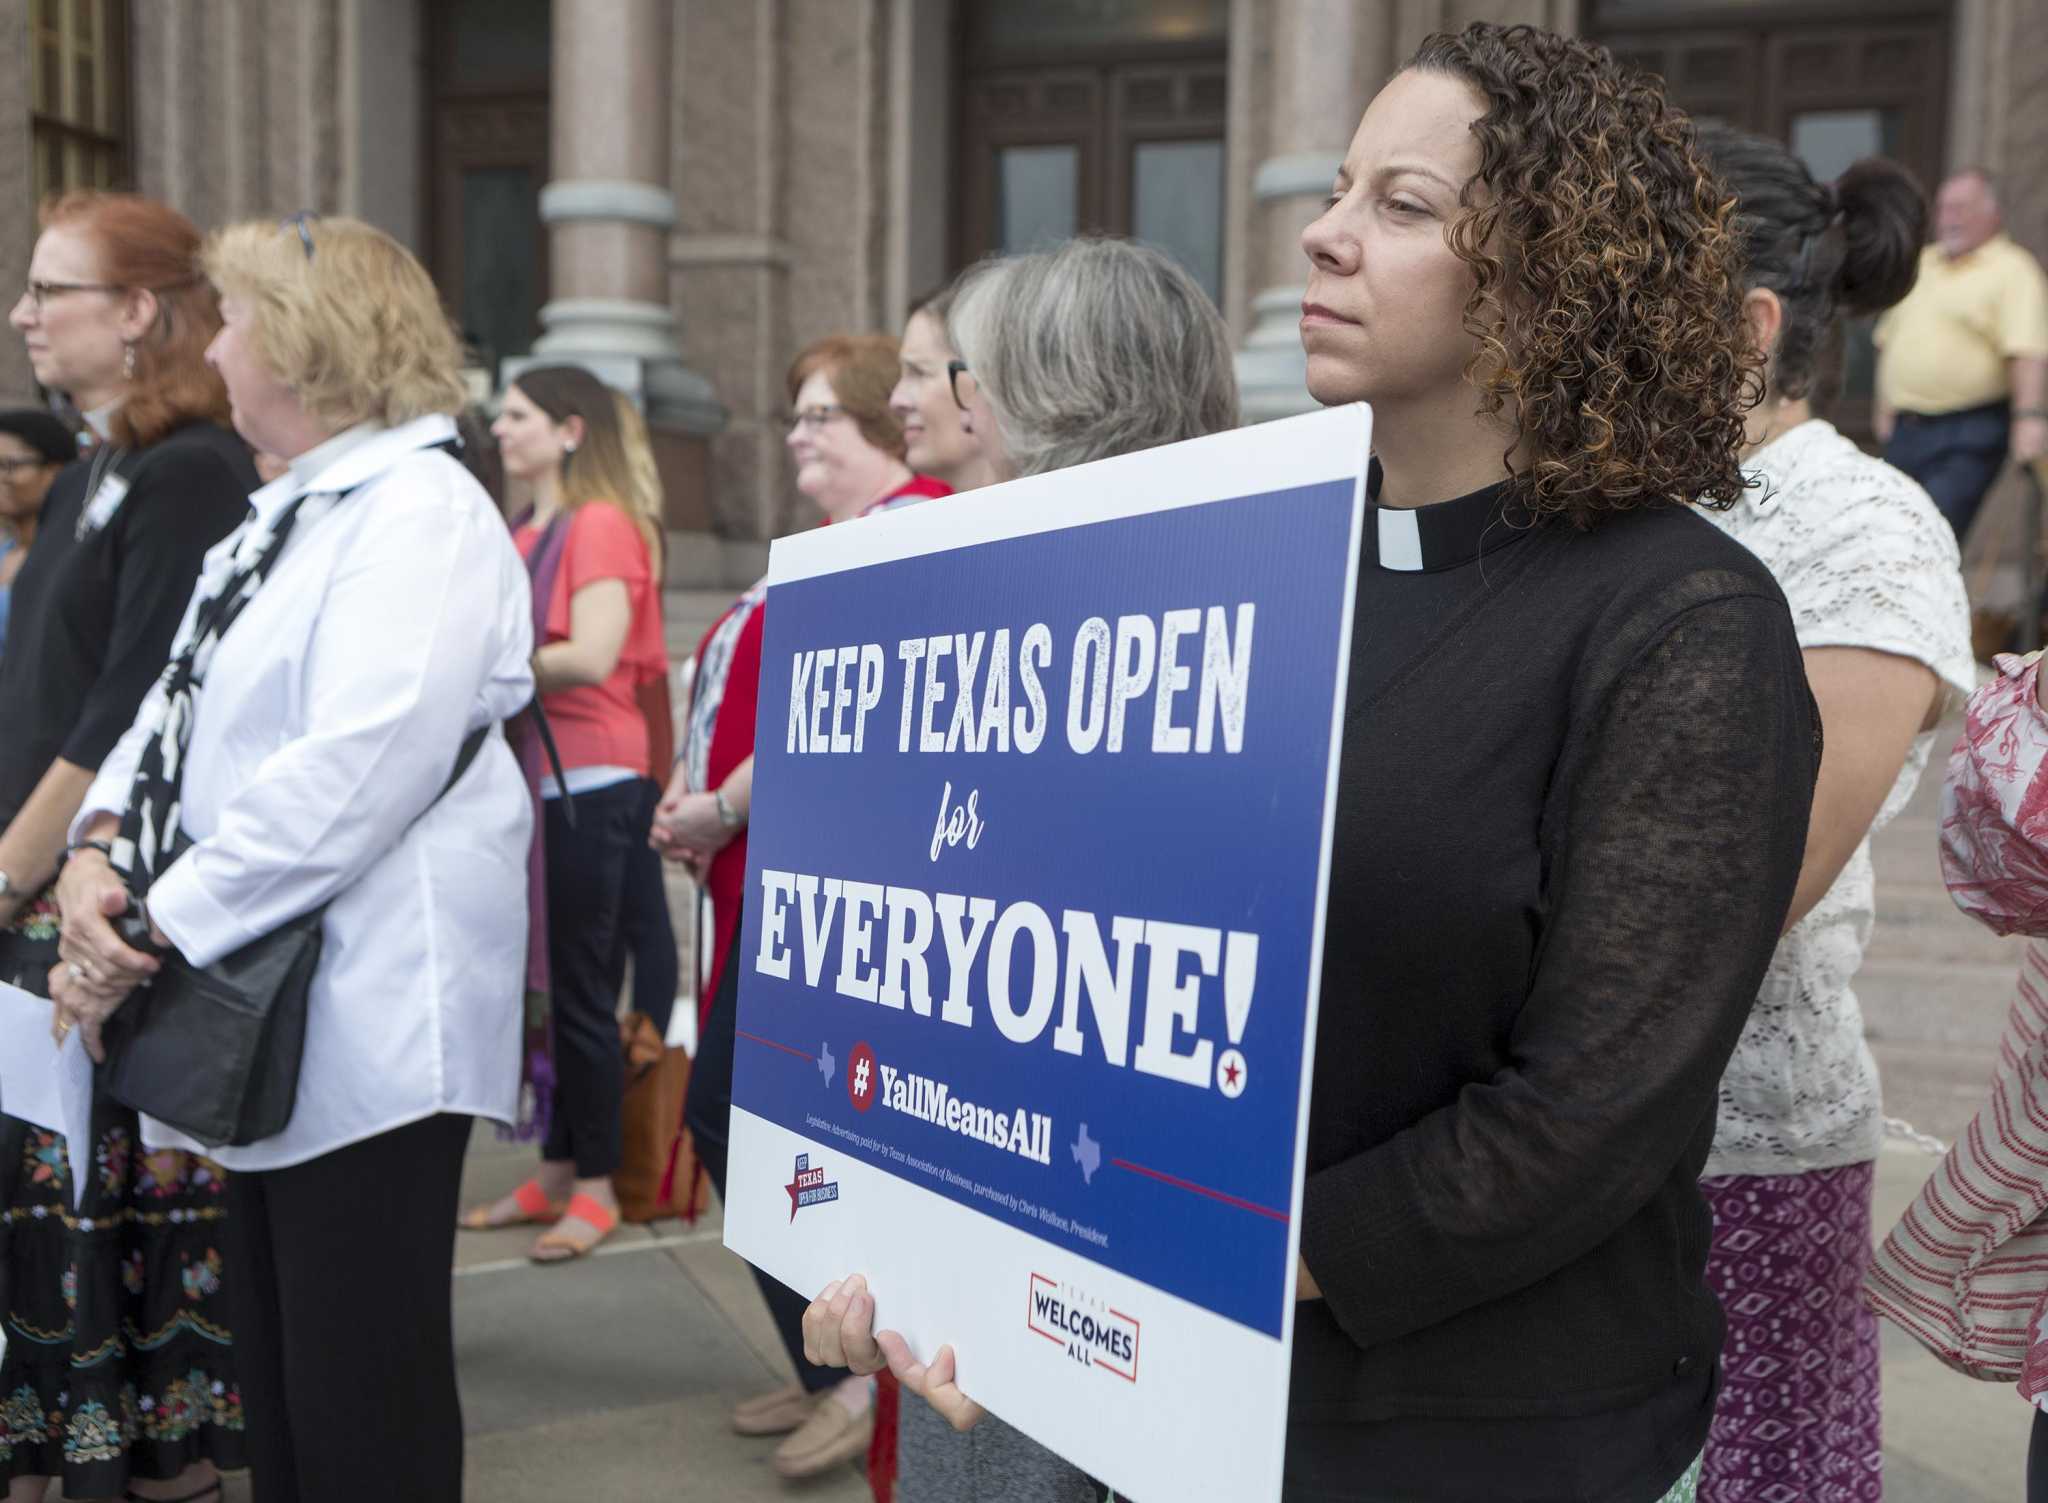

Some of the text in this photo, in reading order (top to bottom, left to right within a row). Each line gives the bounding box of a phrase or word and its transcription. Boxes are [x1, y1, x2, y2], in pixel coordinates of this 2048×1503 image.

[787, 602, 1256, 755] KEEP TEXAS OPEN
[930, 781, 985, 862] for
[756, 869, 1259, 1098] EVERYONE!
[798, 1170, 822, 1188] TEXAS
[831, 1124, 860, 1145] Advertising
[860, 1136, 873, 1149] paid
[889, 1147, 906, 1163] Texas
[906, 1153, 939, 1176] Association
[973, 1183, 1009, 1206] purchased
[1008, 1193, 1018, 1212] by
[1018, 1199, 1038, 1219] Chris
[1035, 1290, 1132, 1362] WELCOMES
[1067, 1342, 1091, 1366] ALL
